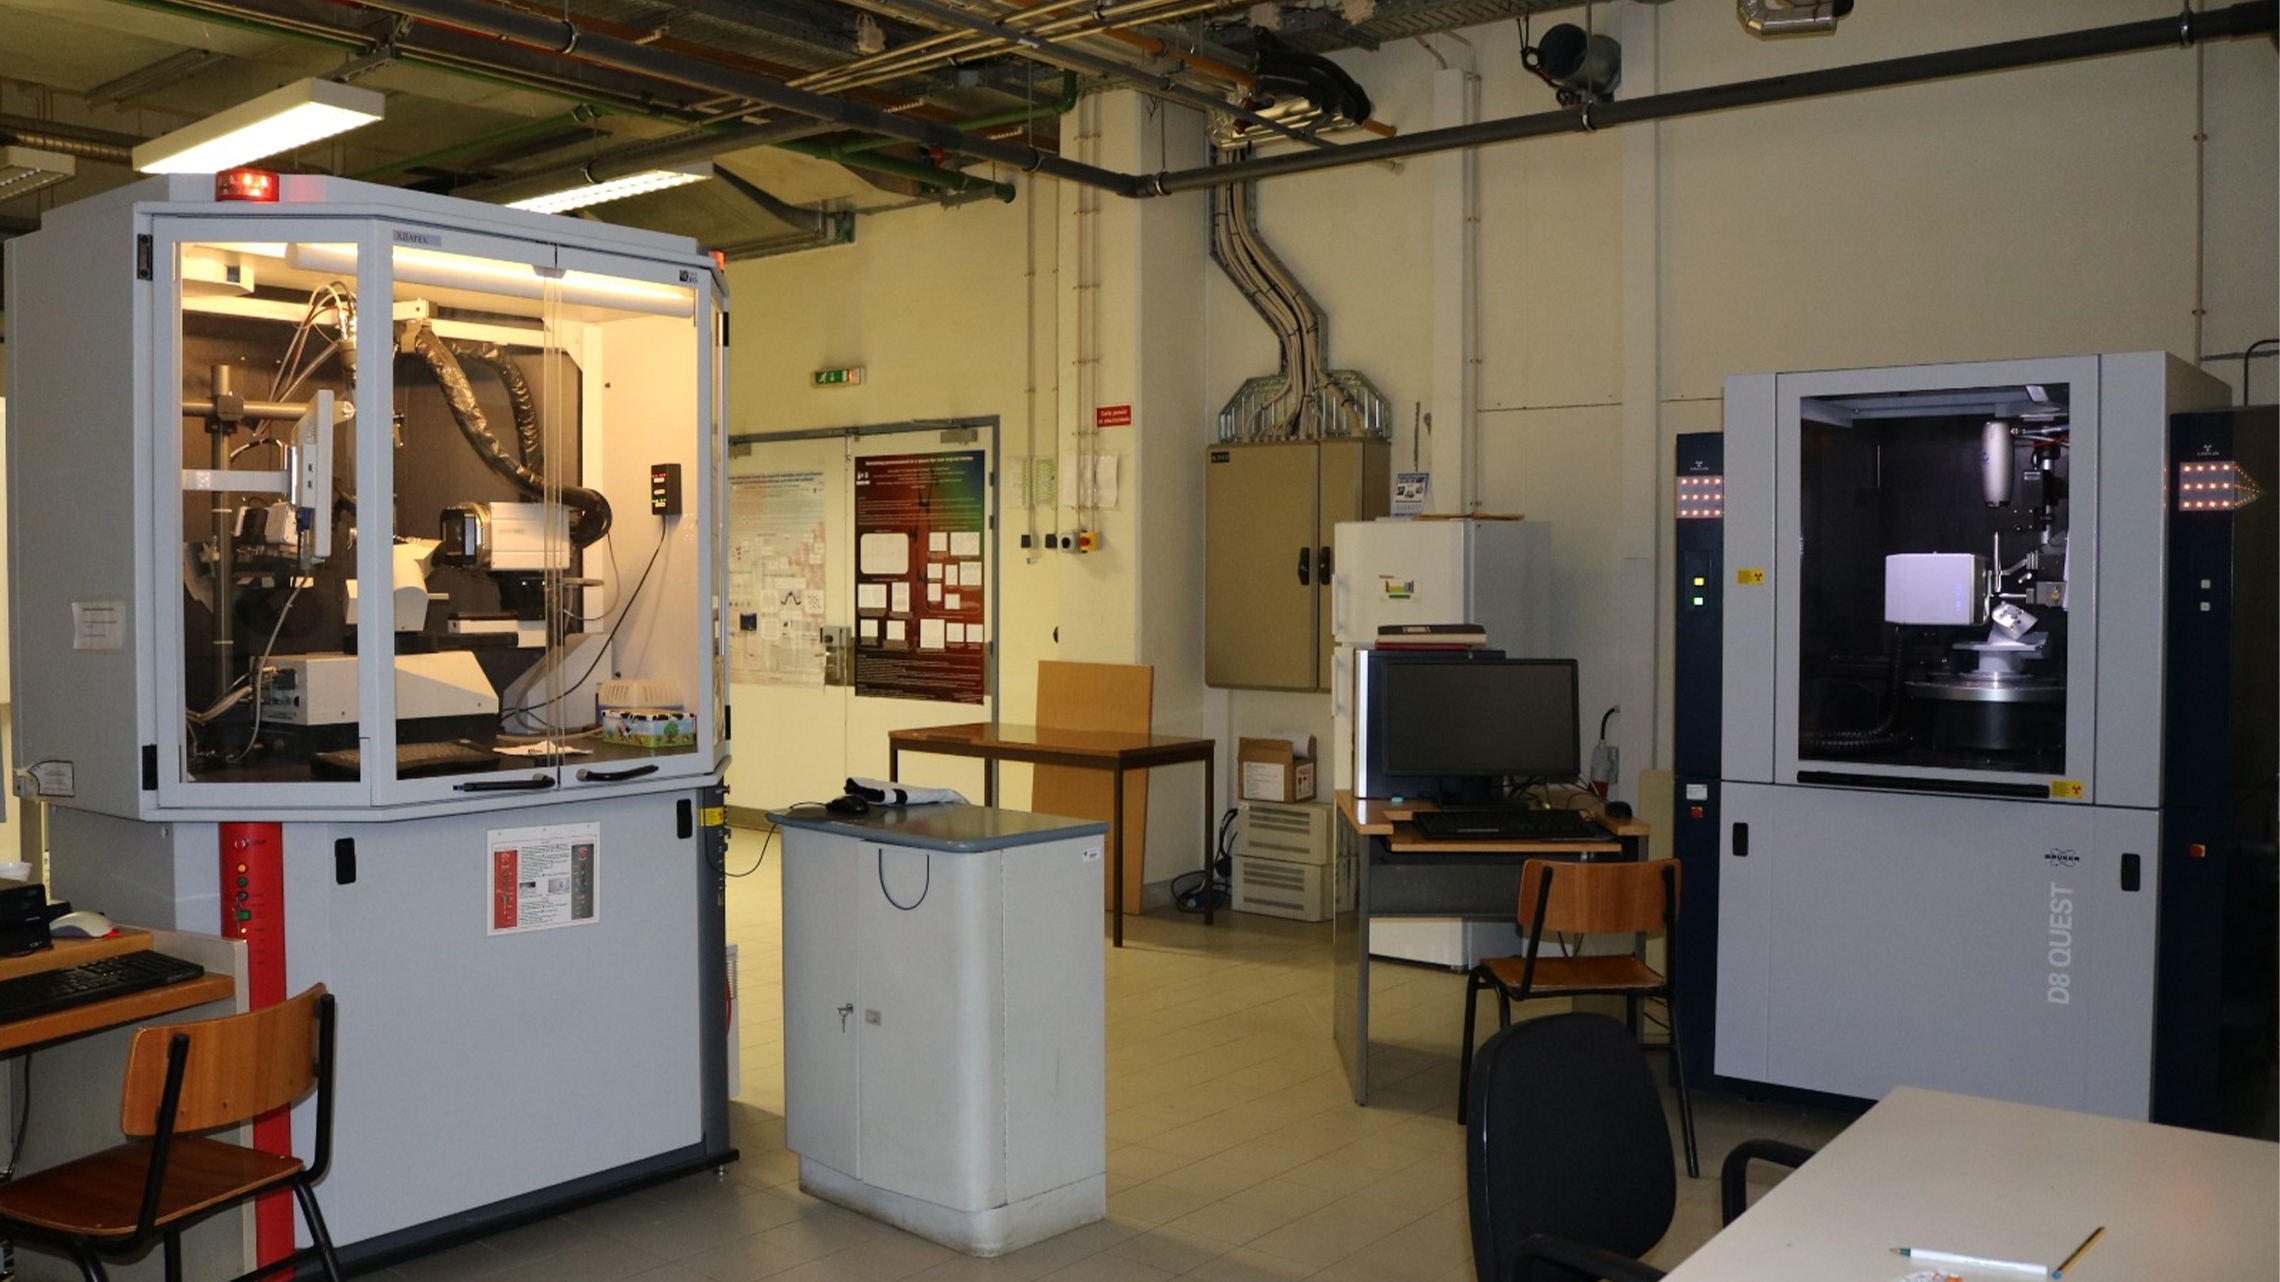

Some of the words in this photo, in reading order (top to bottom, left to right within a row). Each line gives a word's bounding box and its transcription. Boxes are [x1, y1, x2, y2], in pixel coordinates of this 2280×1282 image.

[2044, 854, 2080, 862] BRUKER
[2047, 881, 2074, 968] QUEST
[2046, 972, 2071, 1005] D8
